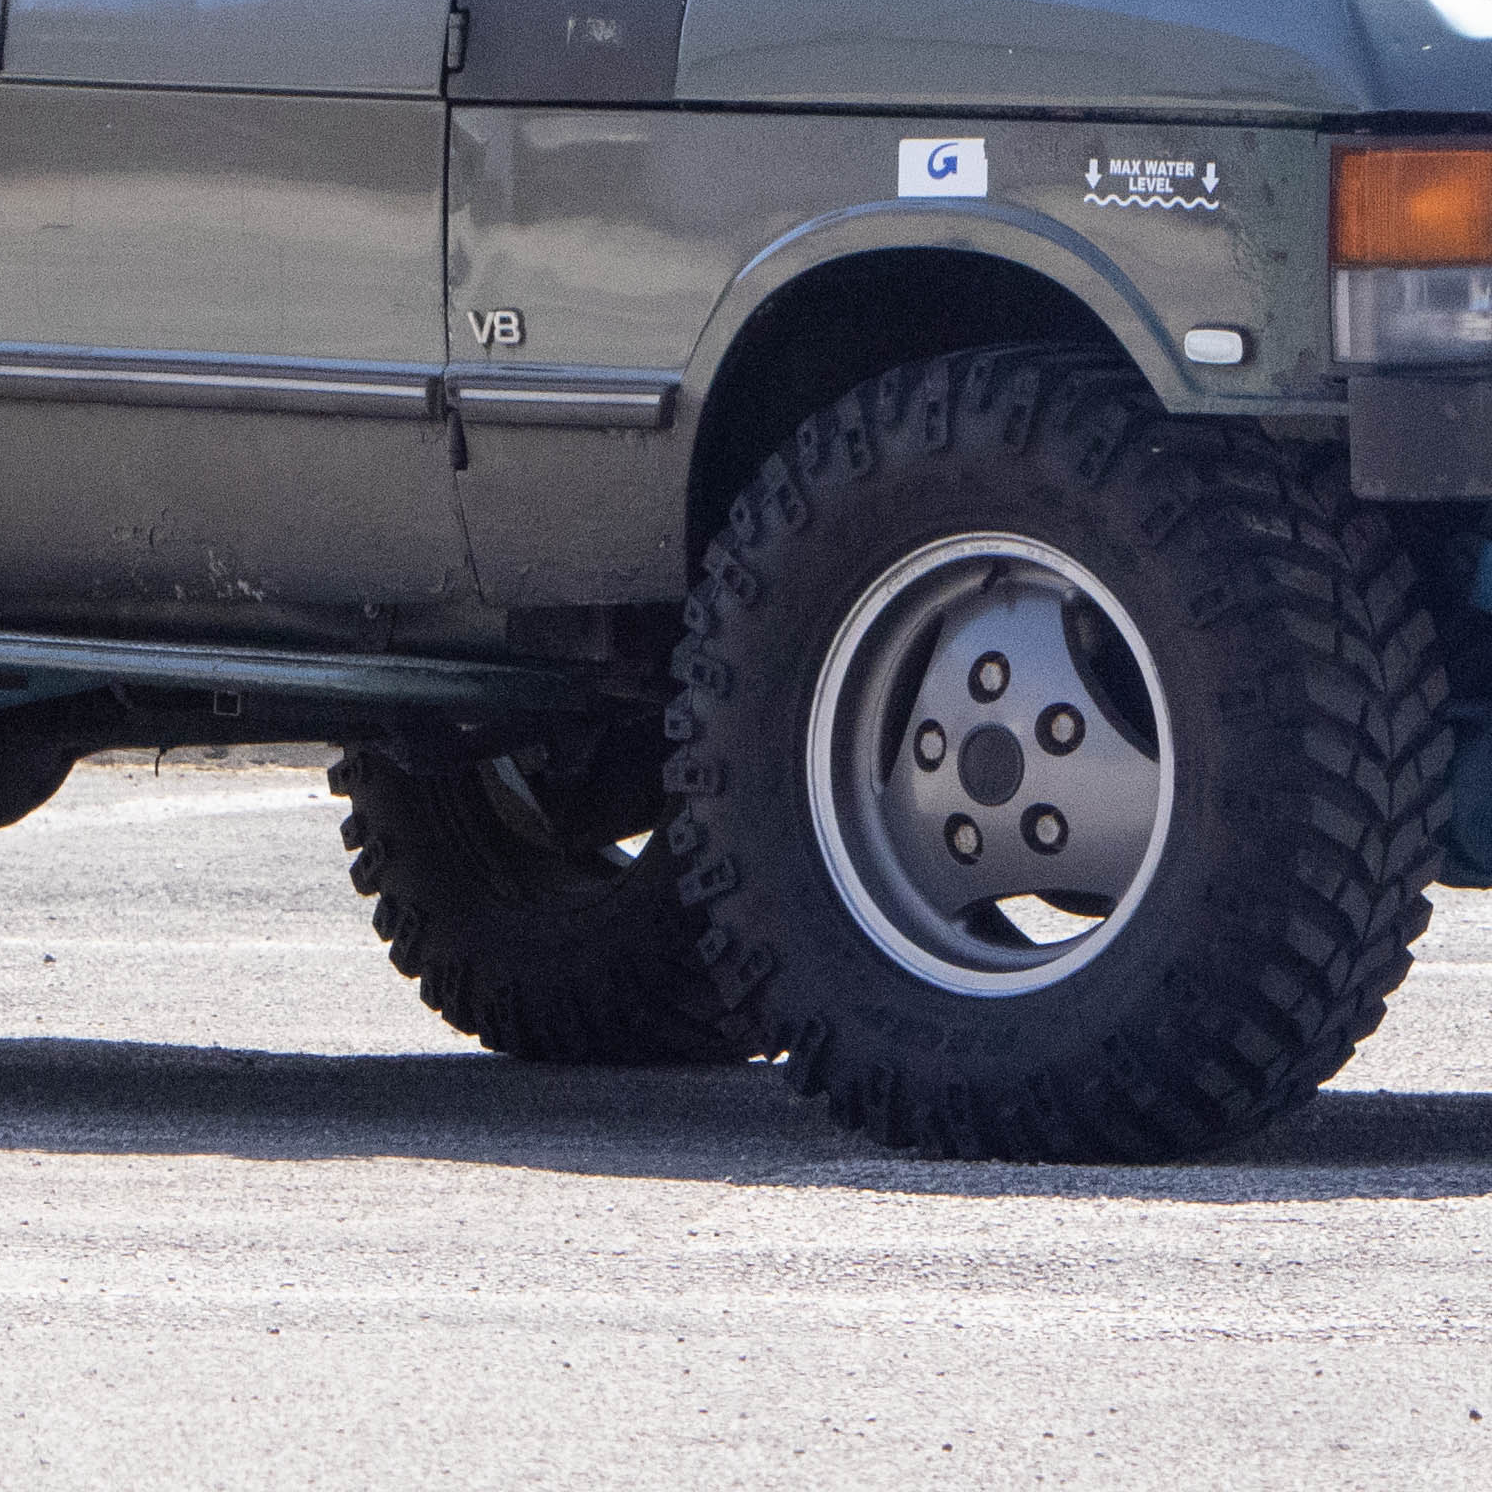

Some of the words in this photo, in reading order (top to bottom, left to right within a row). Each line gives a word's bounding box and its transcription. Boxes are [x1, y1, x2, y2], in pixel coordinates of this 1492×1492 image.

[1109, 159, 1142, 176] MAX
[1144, 160, 1195, 178] WATER
[1128, 177, 1174, 194] LEVEL
[467, 310, 524, 346] V8
